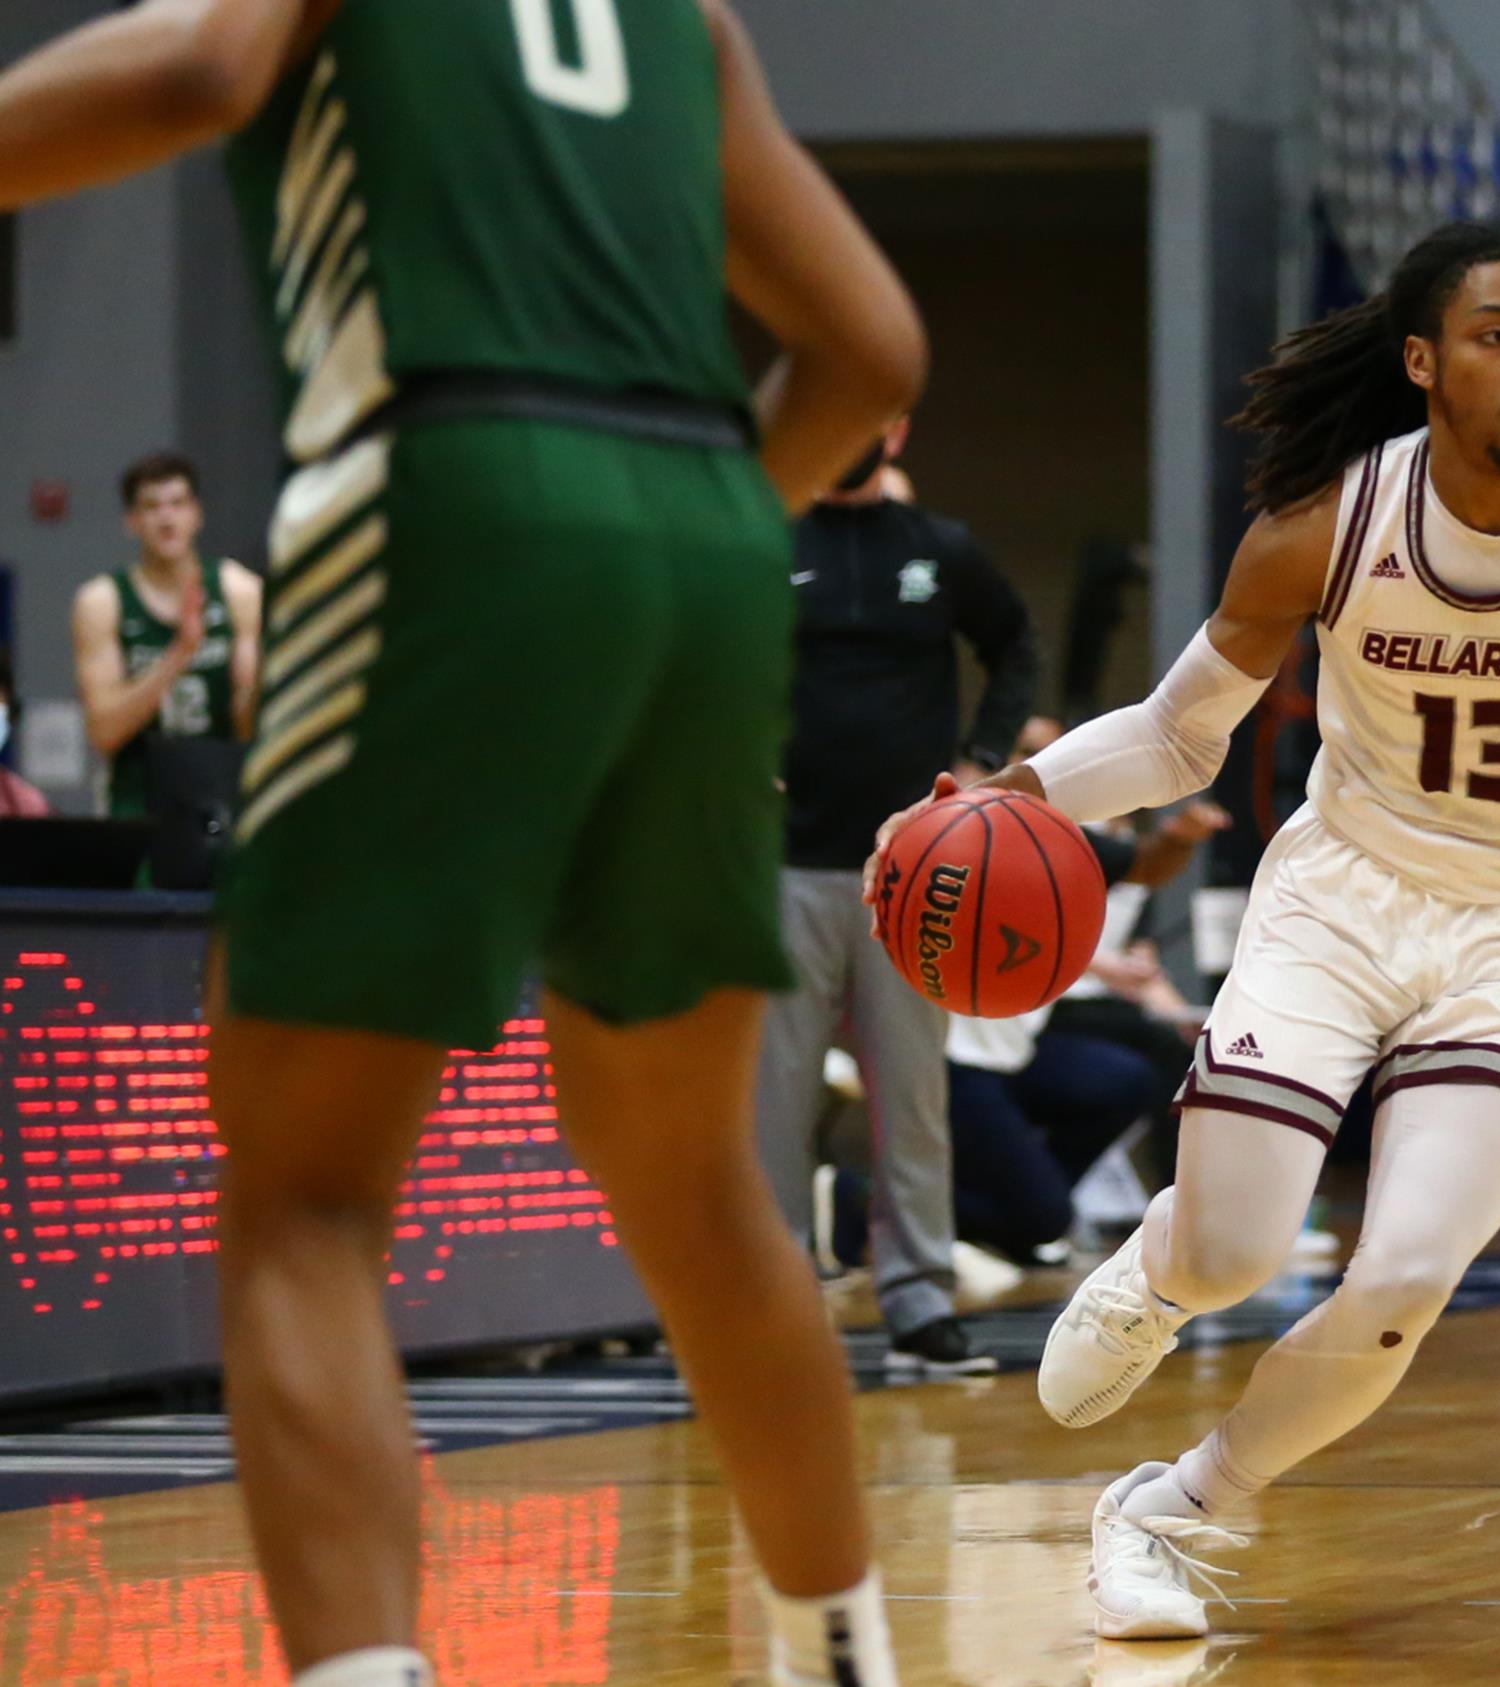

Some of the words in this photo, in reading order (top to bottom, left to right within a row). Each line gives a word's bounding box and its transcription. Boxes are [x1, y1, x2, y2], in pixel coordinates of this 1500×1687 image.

[1369, 567, 1405, 579] adidas
[916, 862, 971, 999] Wilson
[1225, 1046, 1263, 1059] adidas
